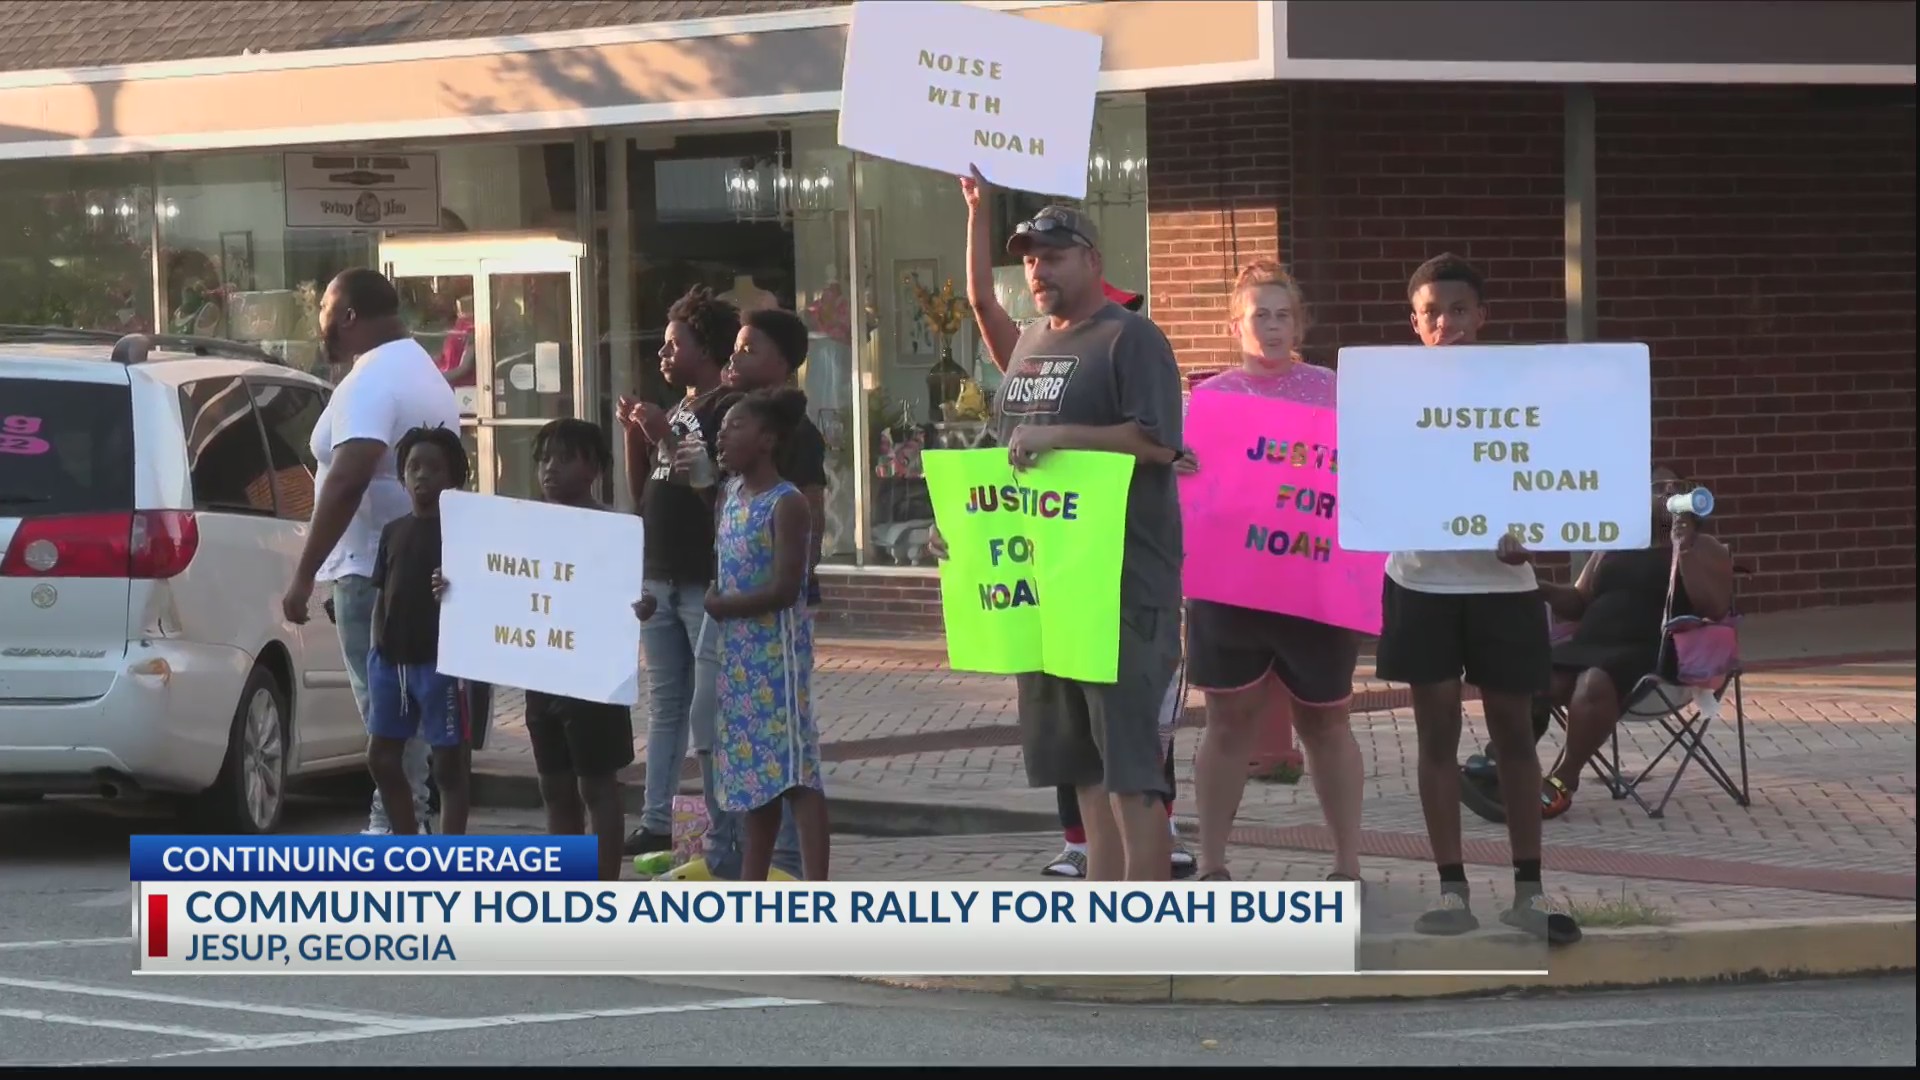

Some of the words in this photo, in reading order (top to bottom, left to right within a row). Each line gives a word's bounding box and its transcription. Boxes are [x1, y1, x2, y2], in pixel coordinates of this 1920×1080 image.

[918, 49, 1002, 80] NOISE
[928, 85, 1001, 115] WITH
[973, 129, 1044, 156] NOAH
[1416, 406, 1541, 429] JUSTICE
[1246, 436, 1339, 474] JUSTI
[1473, 440, 1530, 463] FOR
[1512, 469, 1599, 491] NOAH
[966, 485, 1080, 520] JUSTICE
[1276, 484, 1336, 519] FOR
[1245, 523, 1332, 562] NOAH
[1561, 520, 1620, 543] OLD
[487, 553, 540, 579] WHAT
[553, 561, 575, 582] IF
[531, 593, 552, 615] IT
[979, 577, 1040, 611] NOA
[494, 624, 536, 648] WAS
[547, 628, 575, 650] ME
